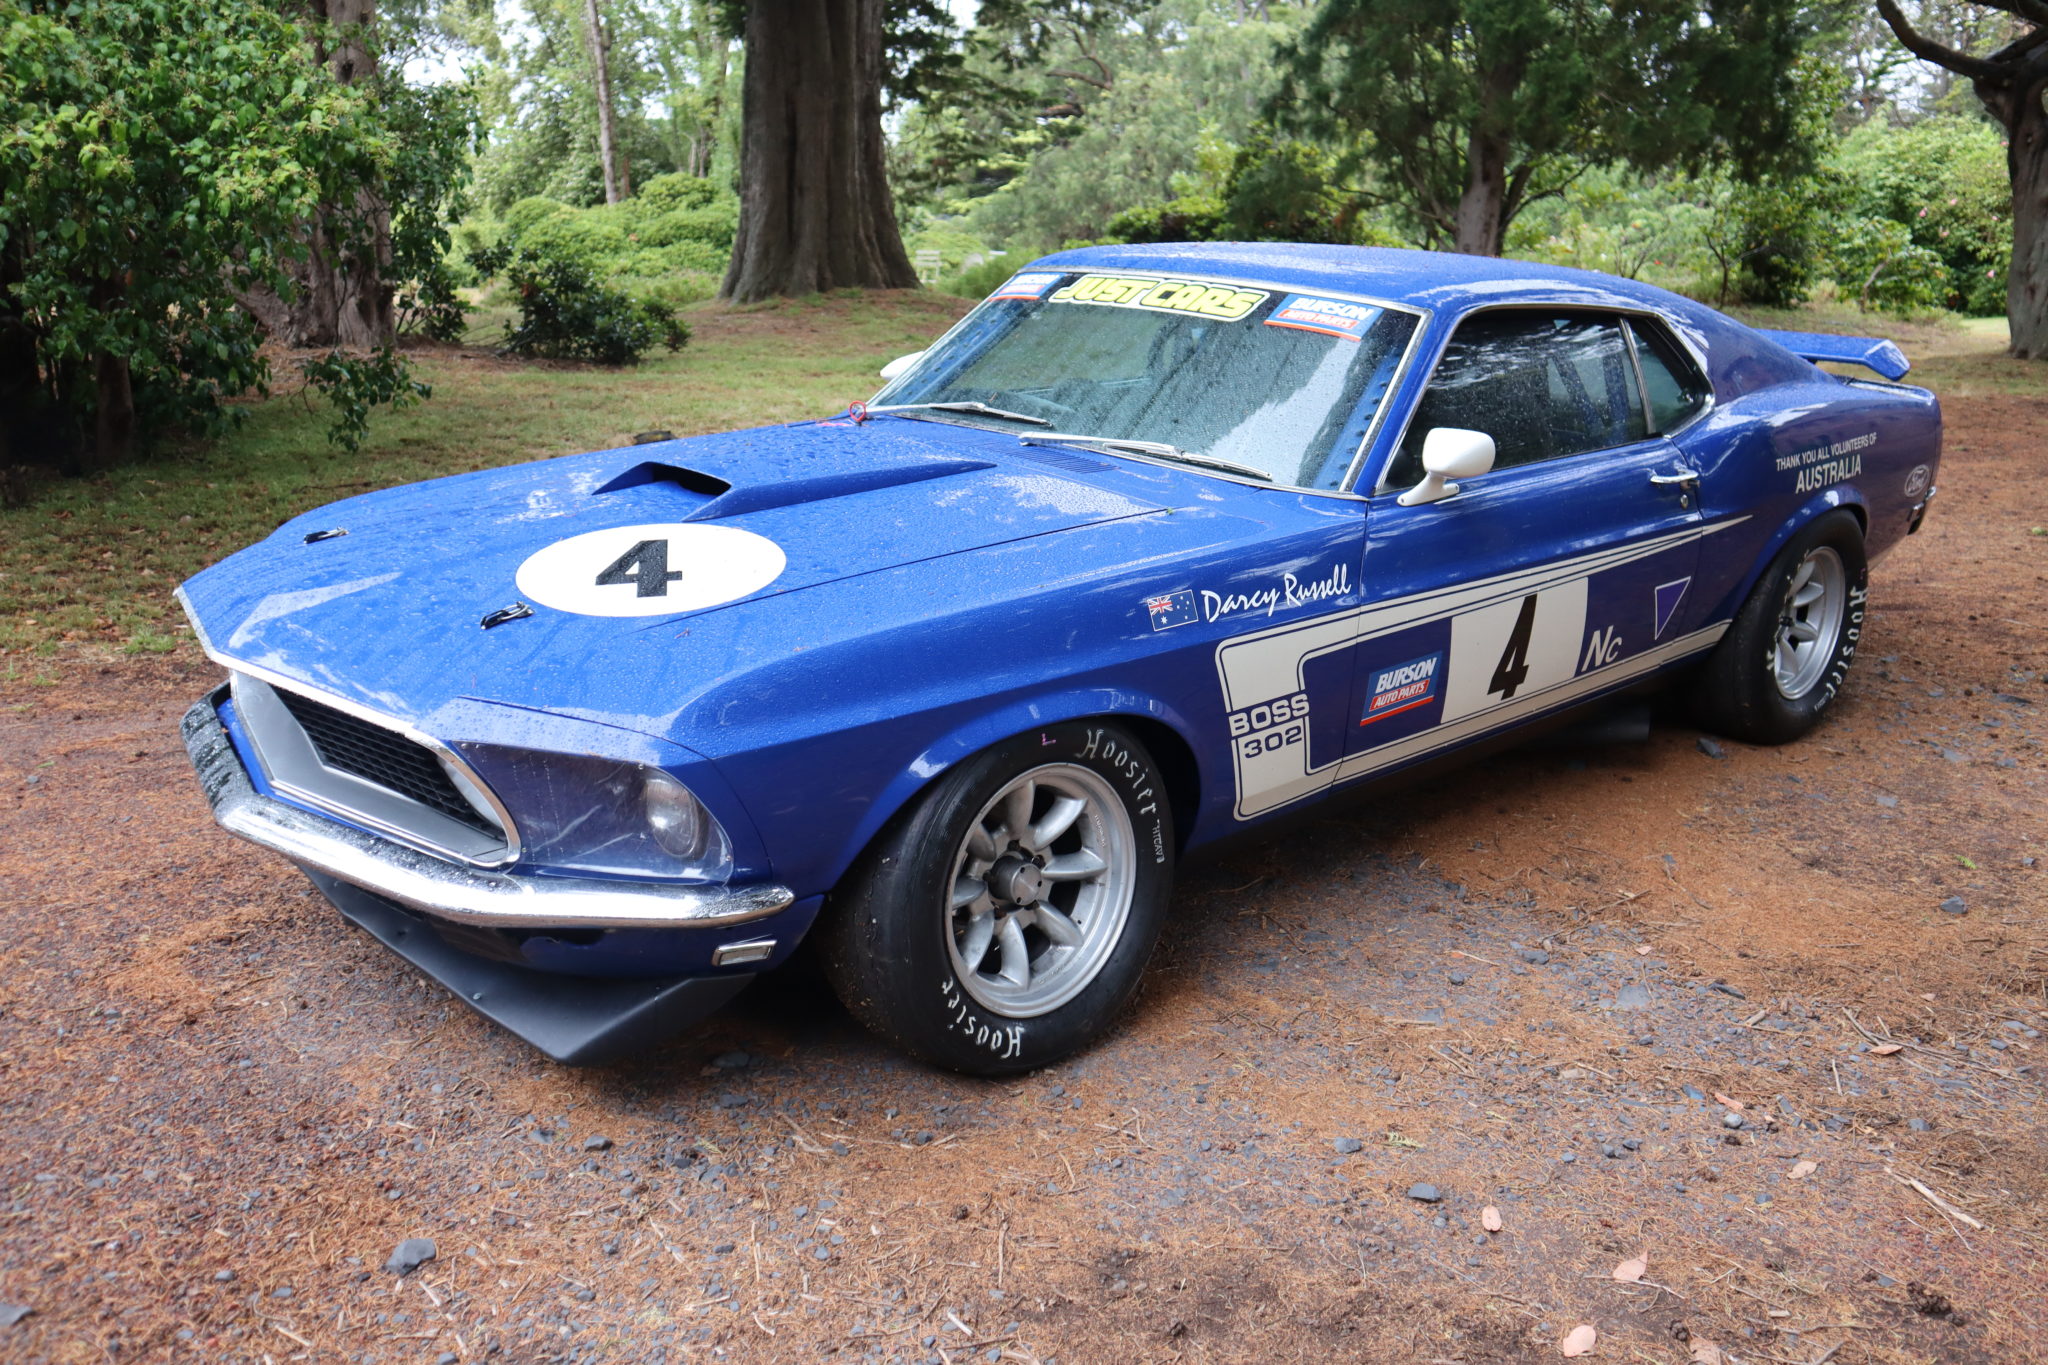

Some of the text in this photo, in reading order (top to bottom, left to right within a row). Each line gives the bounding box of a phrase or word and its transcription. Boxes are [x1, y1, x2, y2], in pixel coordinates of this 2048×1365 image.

[1053, 277, 1160, 304] JUST
[1140, 282, 1265, 318] CARS
[1288, 297, 1375, 321] BURSON
[1775, 432, 1878, 472] THANK YOU ALL VOLUNTEERS OF
[1795, 454, 1862, 494] AUSTRALIA
[595, 539, 682, 598] 4
[1201, 563, 1352, 623] Darcy Russell
[1487, 593, 1538, 701] 4
[1581, 625, 1622, 672] Nc
[1373, 681, 1426, 709] AUTO PARTS
[1375, 656, 1438, 694] BURSON
[1228, 693, 1310, 737] BOSS
[1243, 725, 1303, 759] 302
[1075, 728, 1157, 815] Hoosier
[942, 976, 1025, 1058] Hoosier
